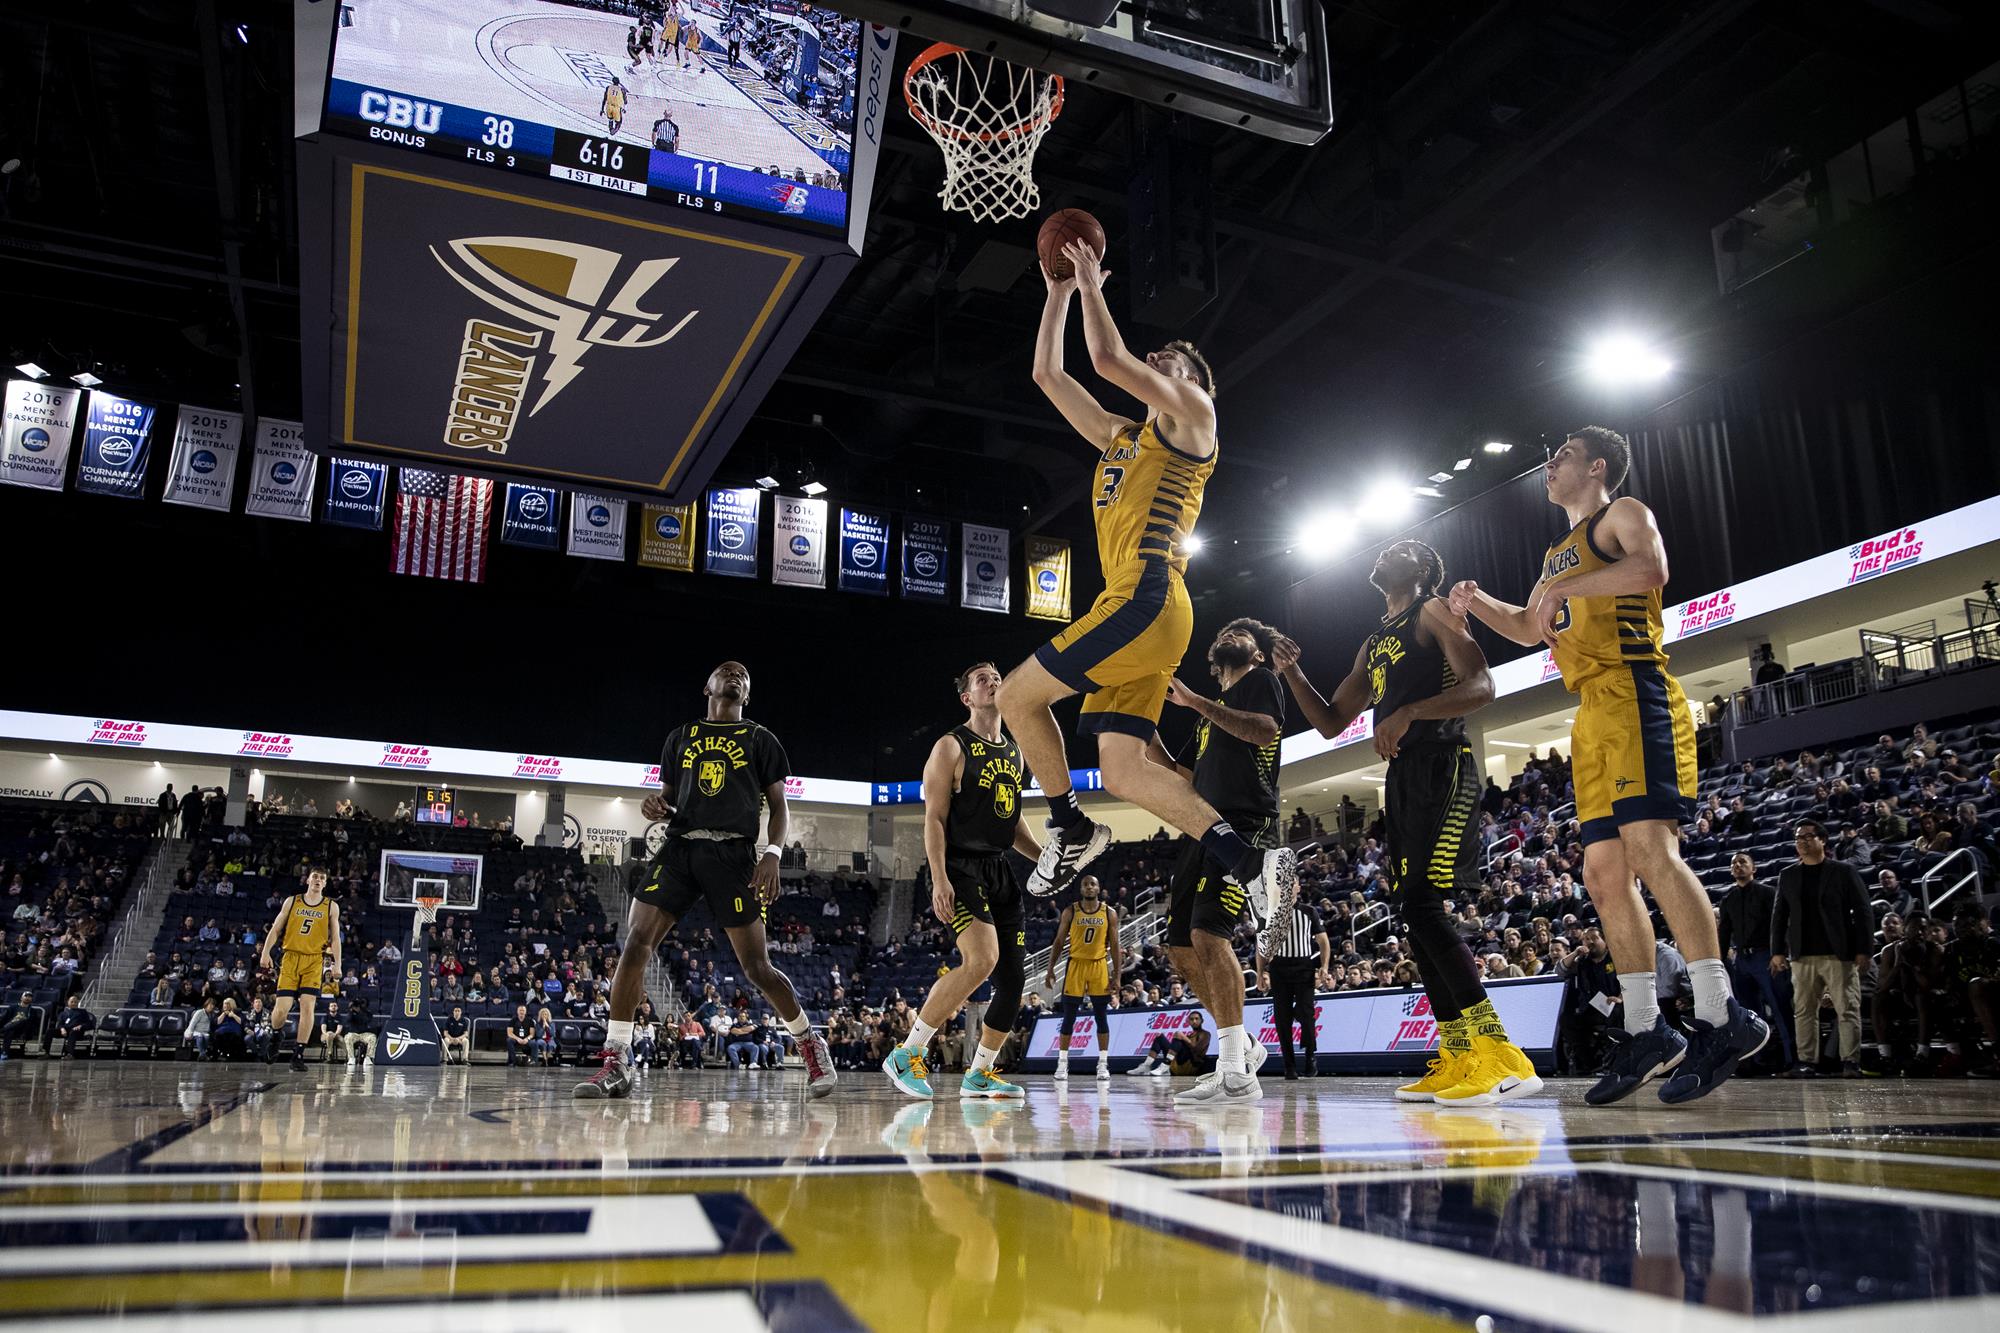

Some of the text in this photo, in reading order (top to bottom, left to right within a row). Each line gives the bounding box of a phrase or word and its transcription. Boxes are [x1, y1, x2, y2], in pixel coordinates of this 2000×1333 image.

[864, 48, 883, 145] pepsi
[359, 90, 443, 134] CBU
[370, 126, 426, 148] BONUS
[482, 116, 515, 149] 38
[467, 147, 515, 167] FLS 3
[579, 139, 623, 170] 6:16
[566, 169, 636, 193] 1ST HALF
[693, 162, 719, 195] 11
[678, 193, 722, 212] FLS 9
[444, 318, 544, 455] LANCERS
[23, 392, 62, 406] 2016
[23, 406, 55, 416] MEN'S
[102, 402, 142, 417] 2016
[7, 412, 70, 428] BASKETBALL
[104, 415, 135, 426] MEN'S
[191, 415, 228, 429] 2015
[193, 429, 222, 439] MEN'S
[177, 436, 235, 450] BASKETBALL
[272, 441, 300, 450] MEN'S
[8, 454, 48, 466] DIVISION
[331, 457, 386, 471] BASKETBALL
[81, 466, 143, 480] TOURNAMENT
[84, 474, 138, 488] CHAMPIONS
[175, 475, 217, 487] DIVISION
[176, 485, 210, 495] SWEET
[260, 487, 296, 497] DIVISION
[251, 493, 309, 506] TOURNAMENT
[327, 499, 380, 513] CHAMPIONS
[708, 511, 756, 523] BASKETBALL
[851, 512, 879, 525] 2017
[506, 520, 557, 533] CHAMPIONS
[846, 523, 882, 534] WOMEN'S
[913, 522, 940, 534] 2017
[573, 528, 622, 540] WEST REGION
[842, 530, 888, 543] BASKETBALL
[972, 532, 998, 544] 2017
[574, 537, 620, 547] CHAMPIONS
[645, 541, 681, 550] DIVISION
[1859, 528, 1916, 559] Bud's
[643, 554, 676, 564] RUNNER
[646, 548, 687, 558] NATIONAL
[707, 550, 754, 561] CHAMPIONS
[782, 558, 811, 567] DIVISION
[1851, 541, 1923, 583] TIRE PROS
[776, 564, 823, 575] TOURNAMENT
[841, 568, 886, 580] CHAMPIONS
[906, 584, 944, 595] CHAMPIONS
[1687, 590, 1731, 616] Bud's
[1680, 603, 1736, 637] TIRE PROS
[101, 720, 145, 732] Bud's
[690, 726, 699, 737] 0
[89, 730, 147, 744] TIRE PROS
[250, 733, 291, 744] Bud's
[240, 743, 294, 756] TIRE PROS
[390, 745, 429, 756] Bud's
[682, 736, 748, 770] BETHESDA
[971, 742, 986, 757] 22
[381, 754, 432, 767] TIRE PROS
[524, 756, 560, 766] Bud's
[515, 765, 562, 777] TIRE PROS
[1086, 771, 1102, 789] 11
[878, 784, 902, 793] TOL 2
[878, 795, 888, 803] FLS
[431, 803, 446, 821] 19
[586, 828, 627, 836] EQUIPPED
[734, 897, 743, 913] 0
[296, 908, 323, 919] LANCERS
[300, 919, 314, 934] 5
[1076, 918, 1104, 926] LANCERS
[1084, 927, 1095, 944] 0
[403, 960, 422, 1017] CBU
[1390, 1020, 1435, 1050] TIRE
